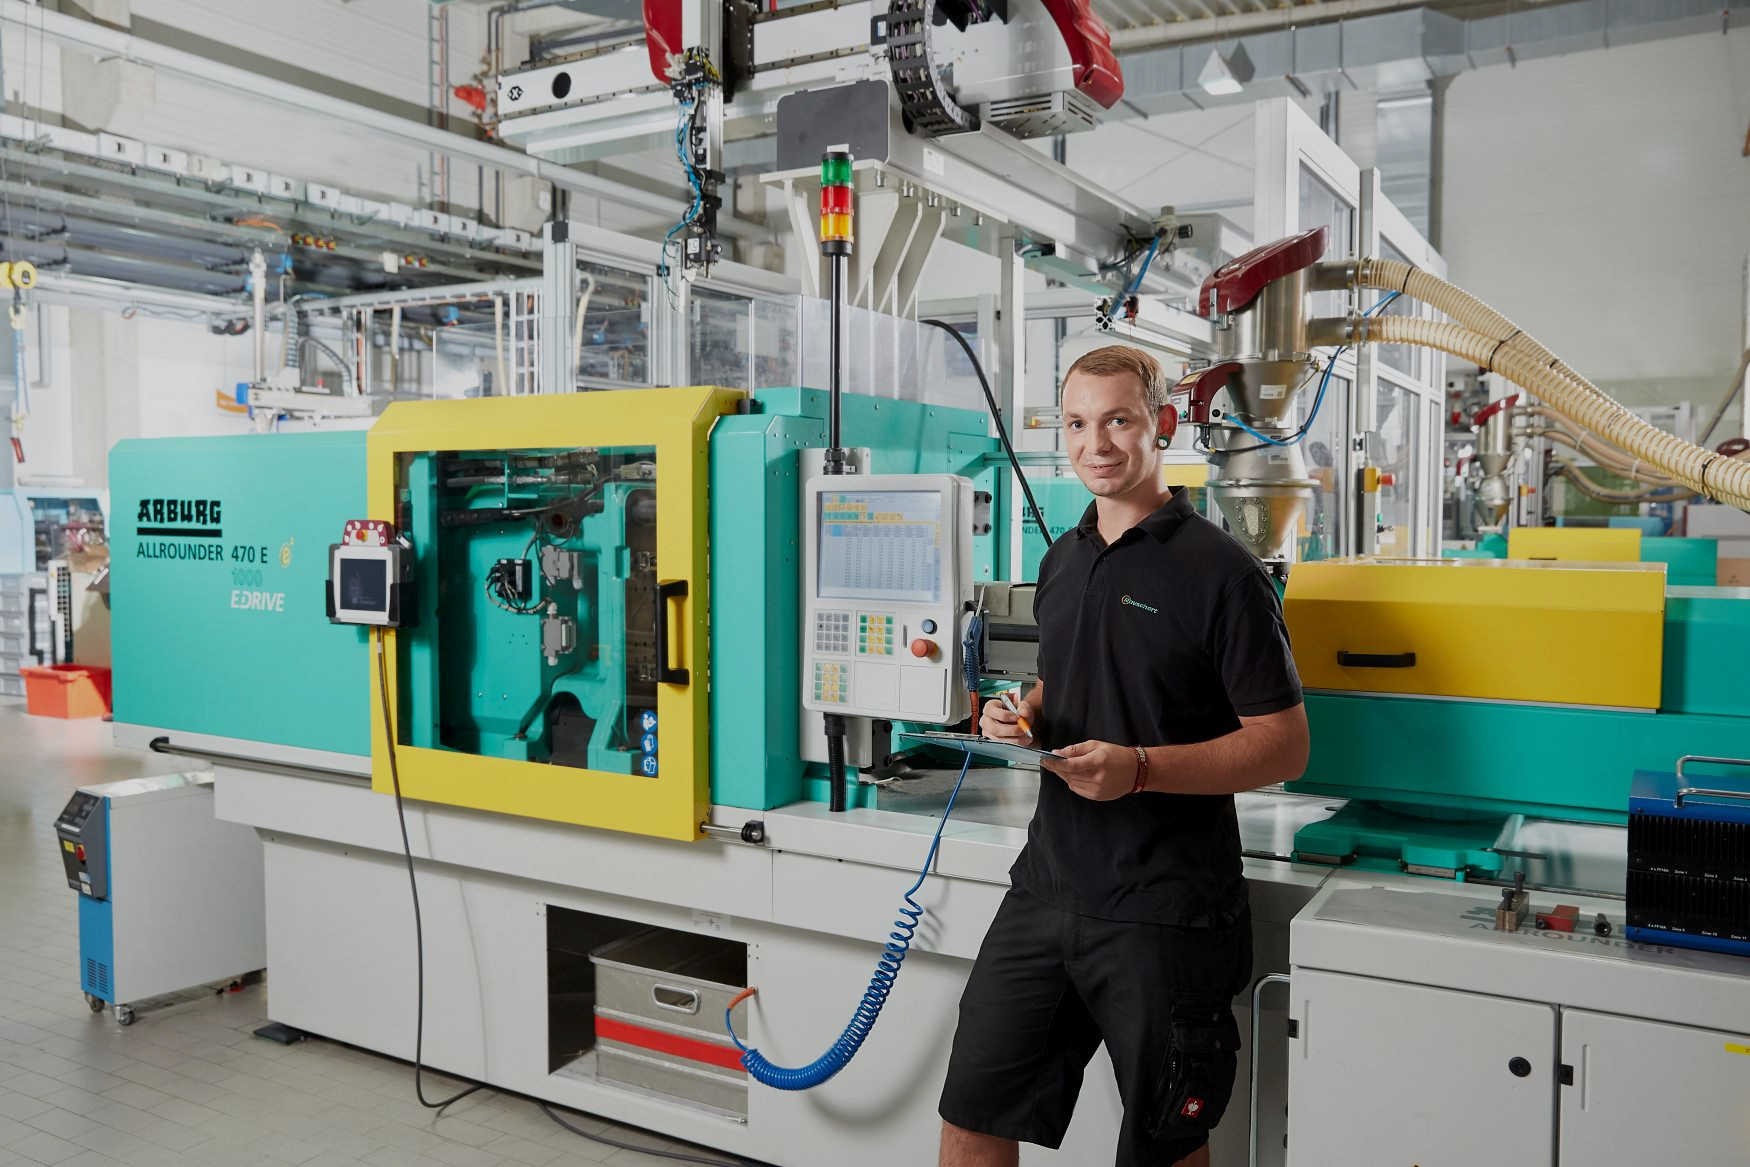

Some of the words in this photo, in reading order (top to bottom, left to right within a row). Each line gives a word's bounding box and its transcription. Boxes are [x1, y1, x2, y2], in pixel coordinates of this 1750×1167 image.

[137, 498, 222, 526] ARBURG
[136, 541, 224, 561] ALLROUNDER
[231, 545, 256, 563] 470
[260, 546, 269, 564] E
[231, 568, 264, 588] 1000
[1469, 922, 1676, 955] AROUNDER
